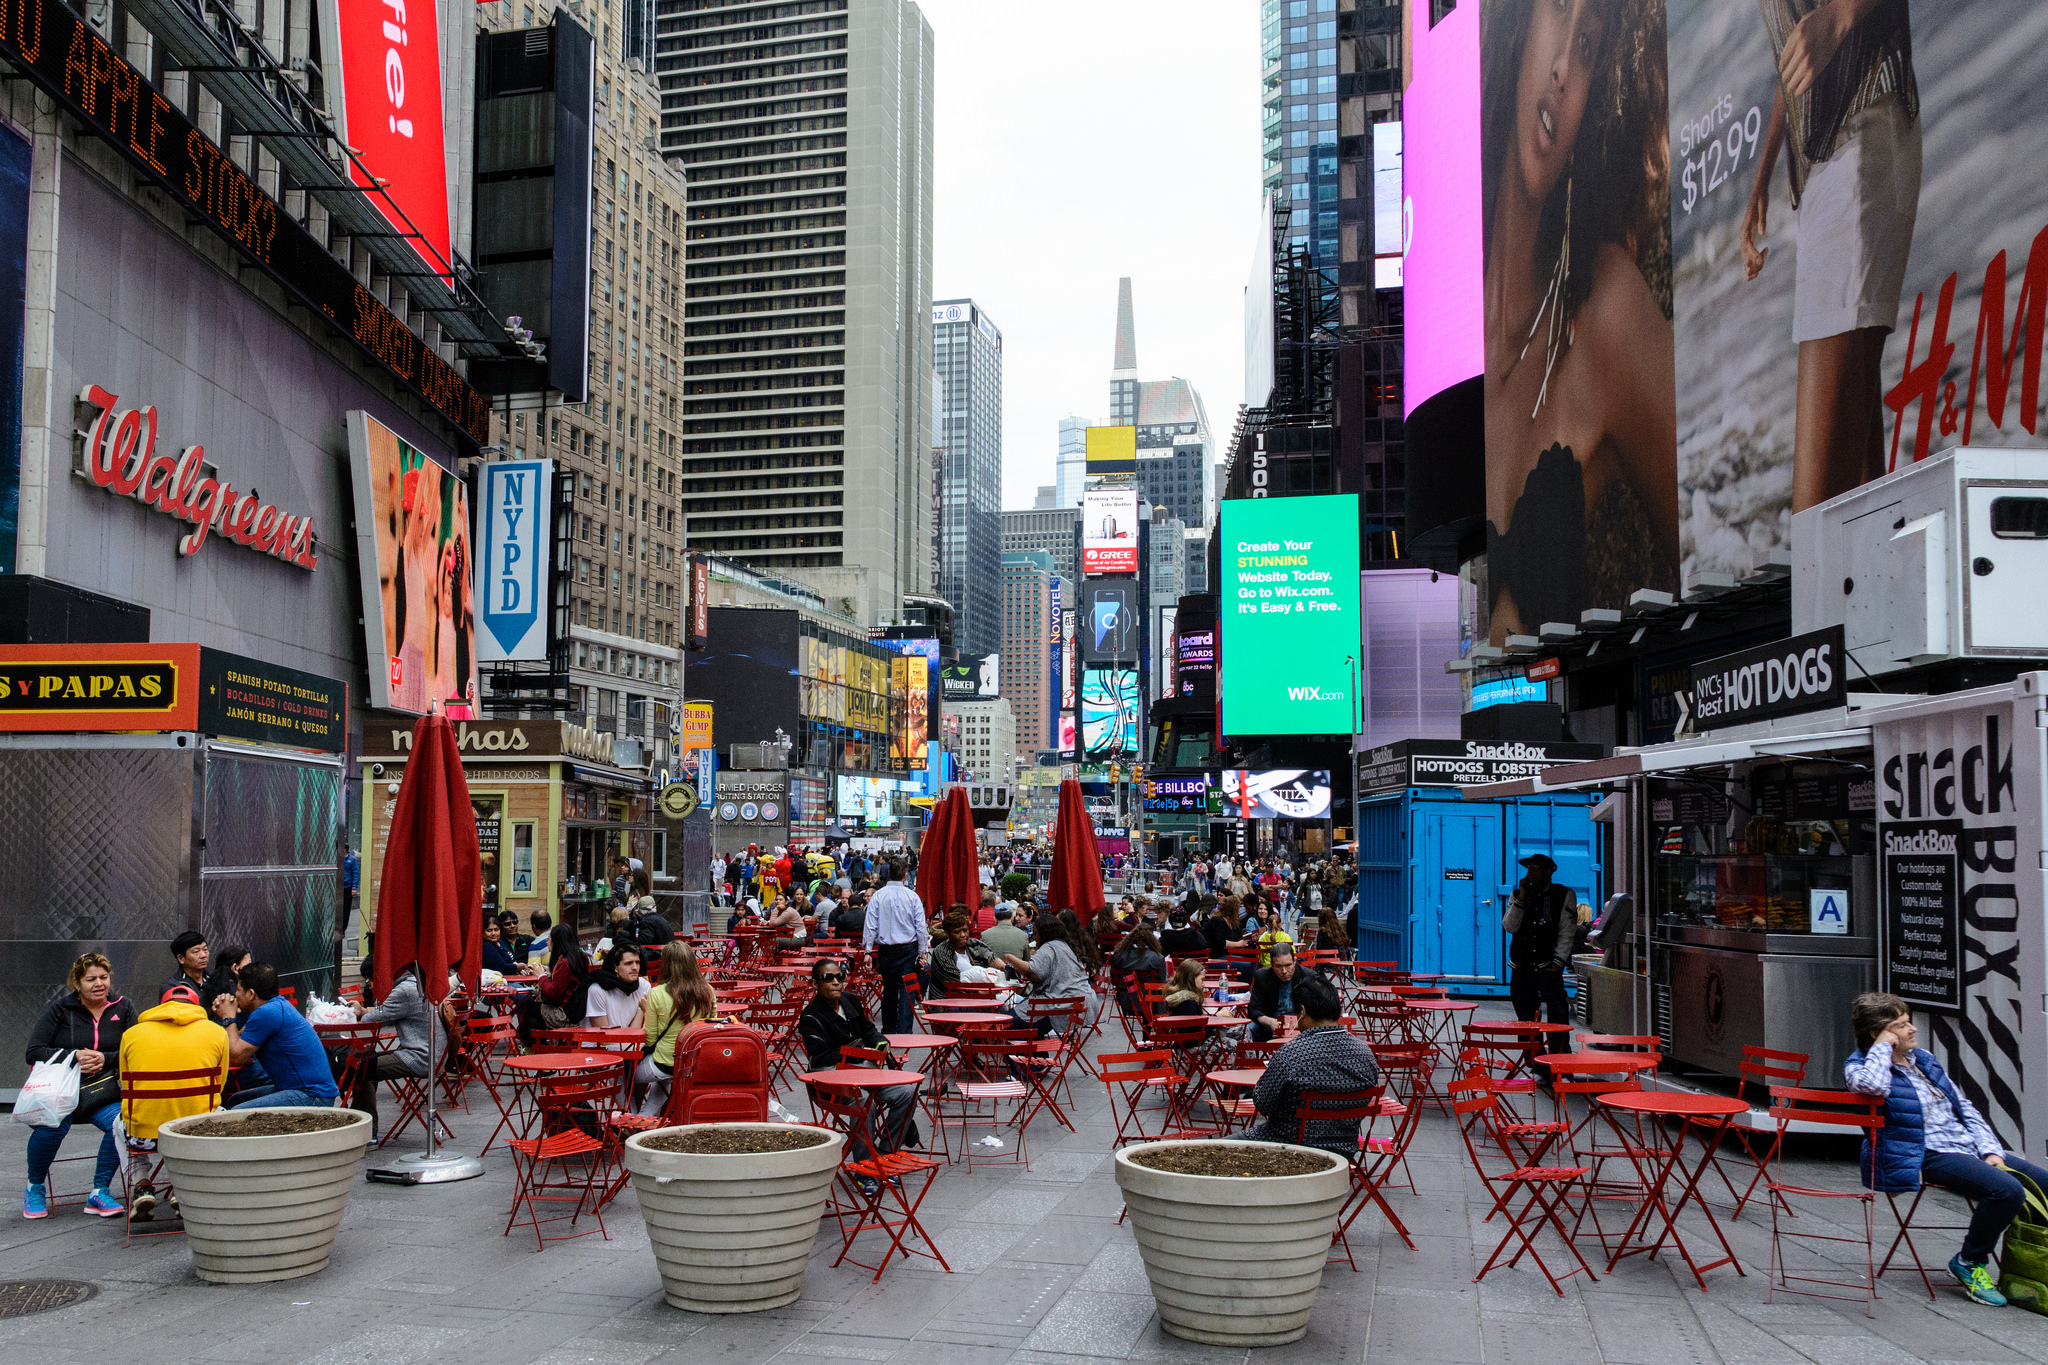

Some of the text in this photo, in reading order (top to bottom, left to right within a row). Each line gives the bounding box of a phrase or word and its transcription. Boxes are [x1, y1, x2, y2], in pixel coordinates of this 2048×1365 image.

[1681, 92, 1733, 158] Shorts
[64, 19, 170, 176] APPLE
[186, 128, 276, 264] STOCK?
[1681, 106, 1761, 215] $12.99
[1884, 224, 2048, 475] H&M
[80, 383, 318, 571] Walgreens
[500, 472, 525, 613] NYPD
[1237, 540, 1313, 553] Create Your
[1099, 551, 1132, 559] GREE
[1237, 554, 1308, 568] STUNNING
[1237, 570, 1333, 583] Website Today.
[1238, 585, 1334, 598] Go to Wix.com.
[1050, 583, 1061, 644] NOVOTEL
[1238, 601, 1342, 614] It's Easy & Free.
[17, 680, 33, 696] Y
[38, 675, 162, 699] PAPAS
[227, 670, 329, 704] SPANISH POTATO TORTILLAS
[1696, 674, 1722, 699] NYC's
[226, 688, 275, 708] BOCADILLOS
[283, 700, 301, 714] COLD
[303, 705, 328, 719] DRINKS
[1697, 696, 1723, 719] best
[226, 706, 255, 721] JAMÓN
[257, 712, 292, 728] SERRANO
[301, 720, 328, 735] QUESOS
[683, 707, 711, 719] BUBBA
[685, 720, 709, 731] GUMP
[391, 721, 530, 751] nhas
[1466, 741, 1546, 760] SnackBox
[463, 770, 540, 779] D-HELD FOODS
[1416, 760, 1551, 775] HOTDOGS LOBSTE
[1453, 774, 1497, 783] PRETZELS
[747, 783, 784, 792] FORCES
[1196, 797, 1206, 808] LI
[1884, 829, 1957, 852] SnackBox
[1897, 862, 1946, 877] Our hotdogs are
[516, 873, 528, 887] A
[1901, 879, 1943, 891] Custom made
[1817, 895, 1842, 922] A
[1901, 896, 1918, 908] 100%
[1919, 896, 1928, 907] All
[1901, 913, 1944, 928] Natural casing
[1904, 929, 1942, 945] Perfect snap
[1899, 946, 1947, 961] Slightly smoked
[1920, 966, 1935, 977] then
[1935, 967, 1955, 980] grilled
[1900, 980, 1948, 996] on toasted bun!
